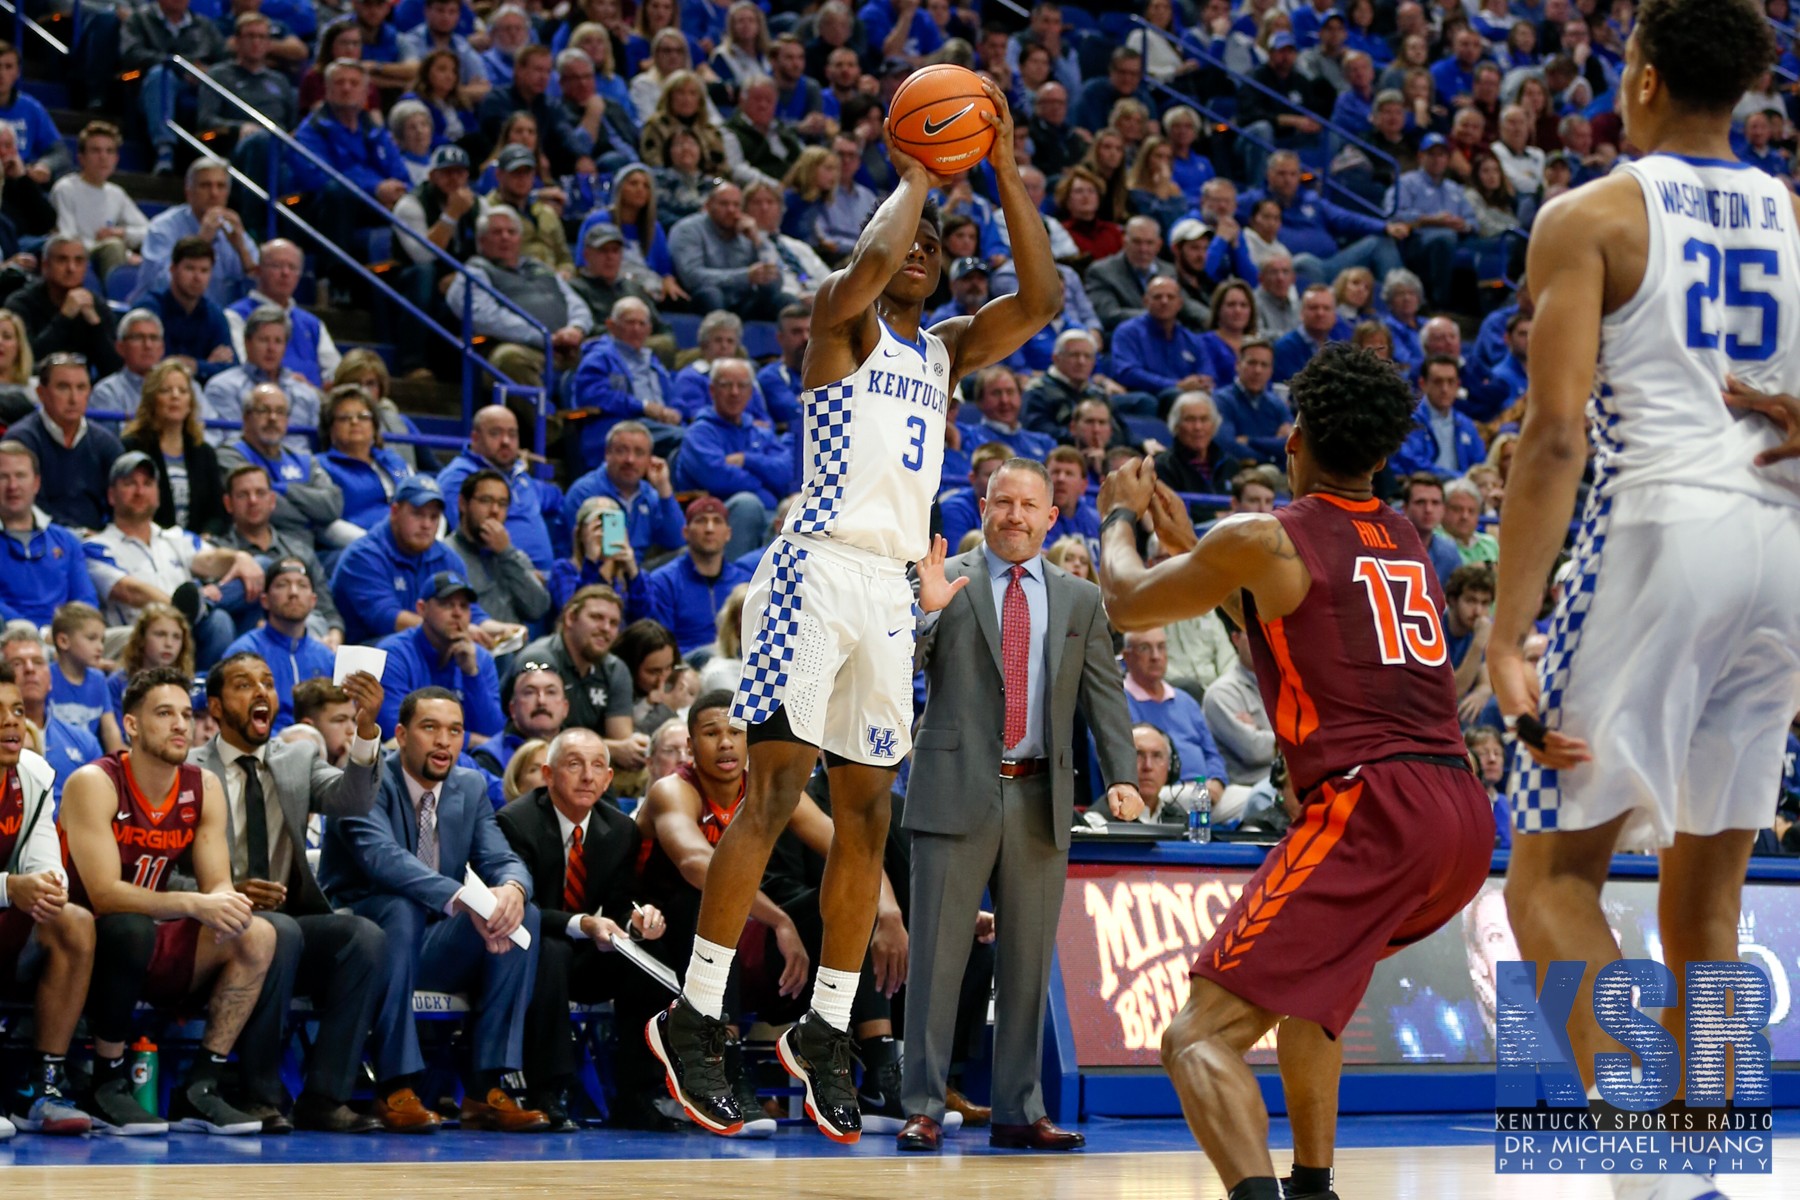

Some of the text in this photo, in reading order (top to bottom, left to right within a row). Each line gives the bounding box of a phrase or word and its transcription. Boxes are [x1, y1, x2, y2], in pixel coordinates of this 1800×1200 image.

[1655, 180, 1785, 232] WASHINGTON JR.
[1683, 237, 1780, 361] 25
[902, 415, 927, 472] 3
[1351, 519, 1399, 549] HILL
[1352, 556, 1448, 667] 13
[112, 821, 195, 850] VIRGINIA
[134, 854, 169, 892] 11
[1084, 881, 1244, 1001] MING
